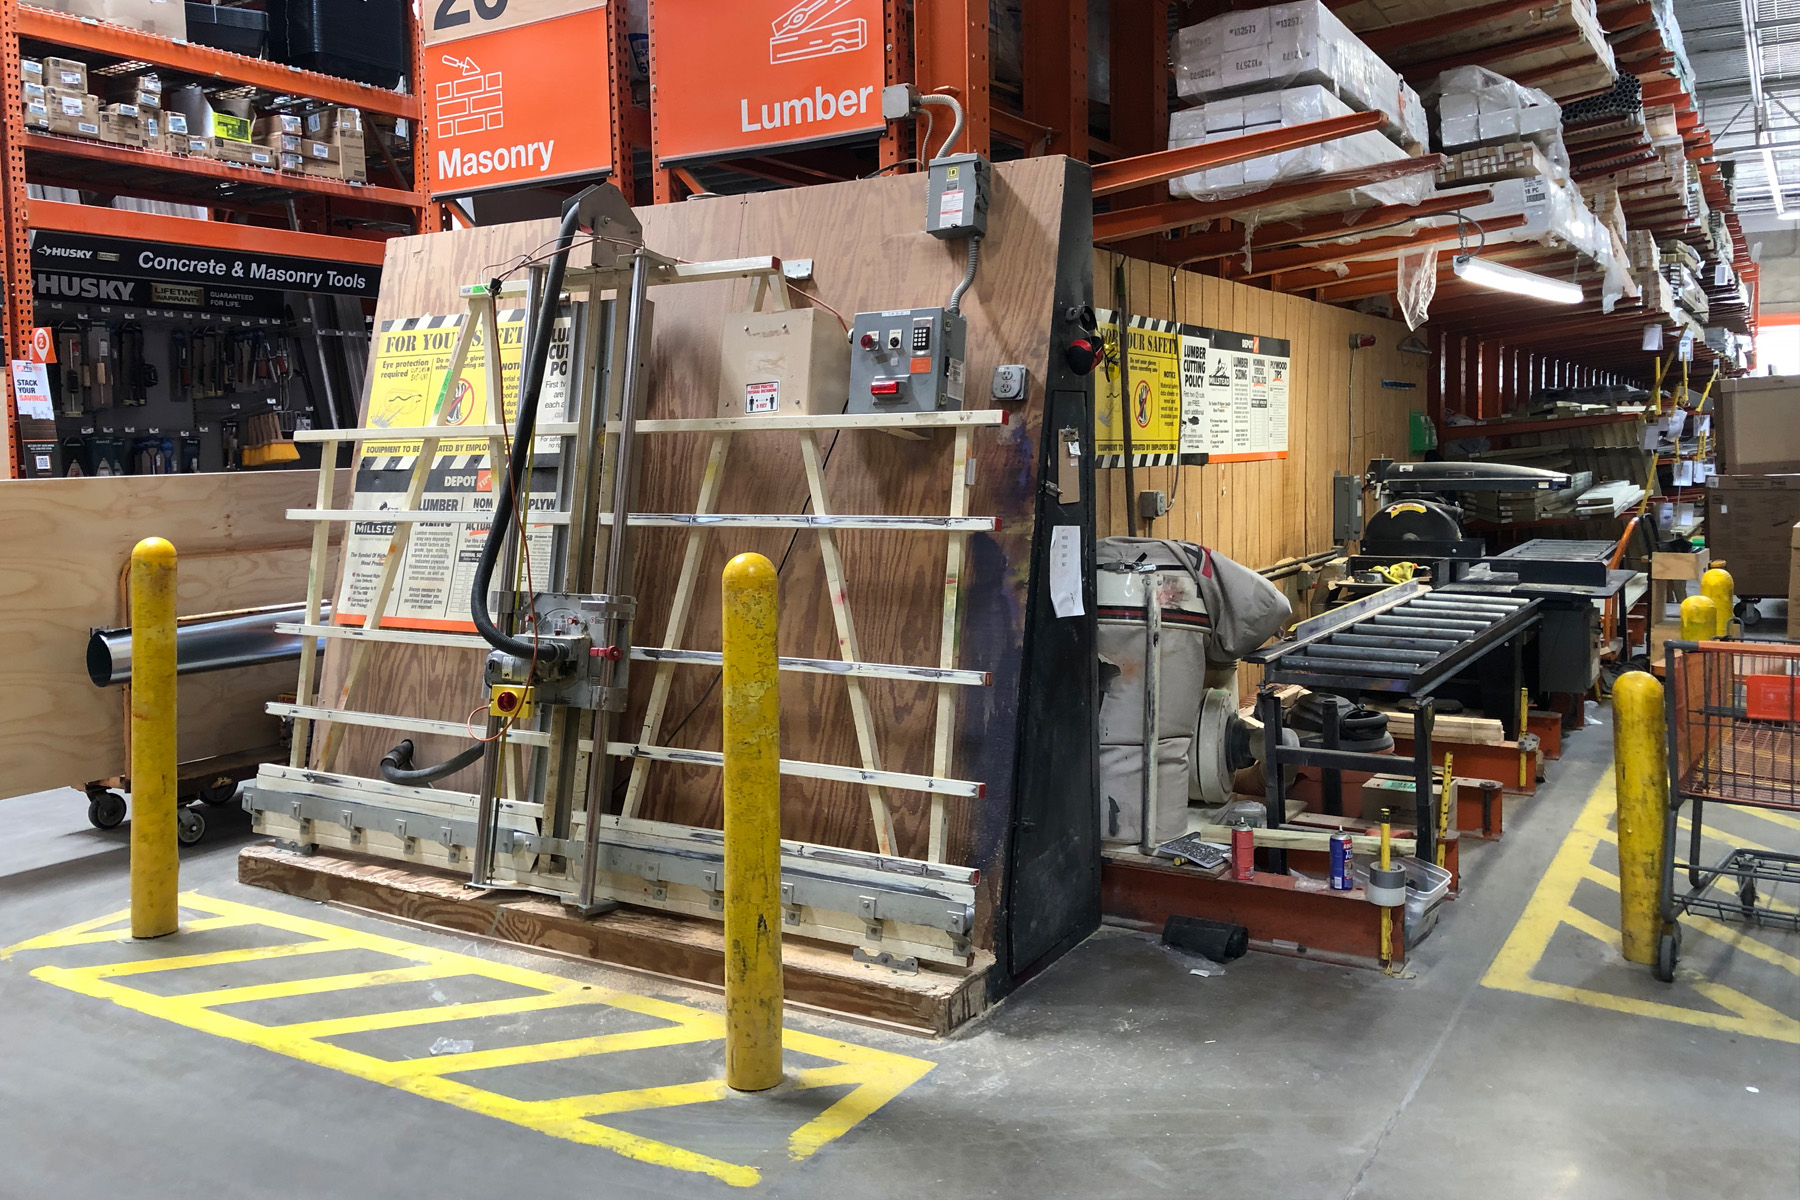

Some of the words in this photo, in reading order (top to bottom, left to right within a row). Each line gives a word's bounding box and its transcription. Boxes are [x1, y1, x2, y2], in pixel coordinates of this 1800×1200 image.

[1230, 25, 1256, 36] #132573
[741, 85, 873, 133] Lumber
[438, 139, 554, 180] Masonry
[51, 247, 93, 259] HUSKY
[138, 251, 226, 275] Concrete
[231, 261, 244, 277] &
[250, 263, 323, 288] Masonry
[327, 270, 366, 289] Tools
[37, 274, 135, 301] HUSKY
[154, 287, 200, 297] LIFETIME
[210, 291, 254, 301] GUARANTEED
[38, 338, 44, 348] 2
[385, 335, 417, 353] FOR
[423, 332, 455, 351] YOU
[1127, 332, 1145, 351] OUR
[1148, 335, 1177, 355] SAFETY
[1184, 345, 1206, 359] LUMBER
[382, 361, 394, 370] Eye
[395, 359, 429, 369] protection
[470, 355, 485, 363] glove
[502, 363, 520, 371] NOTI
[1184, 359, 1206, 374] CUTTING
[1270, 360, 1287, 370] PLYWOOD
[381, 370, 409, 379] required
[1163, 371, 1176, 379] NOTICE
[1185, 374, 1204, 388] POLICY
[19, 394, 47, 402] SAVINGS
[366, 445, 400, 454] EQUIPMENT
[402, 445, 410, 453] TO
[411, 445, 420, 453] BE
[455, 444, 464, 452] BY
[465, 443, 490, 451] EMPLOY
[444, 475, 477, 487] DEPOT
[528, 499, 556, 510] PLYW
[356, 523, 396, 534] MILLSTEA
